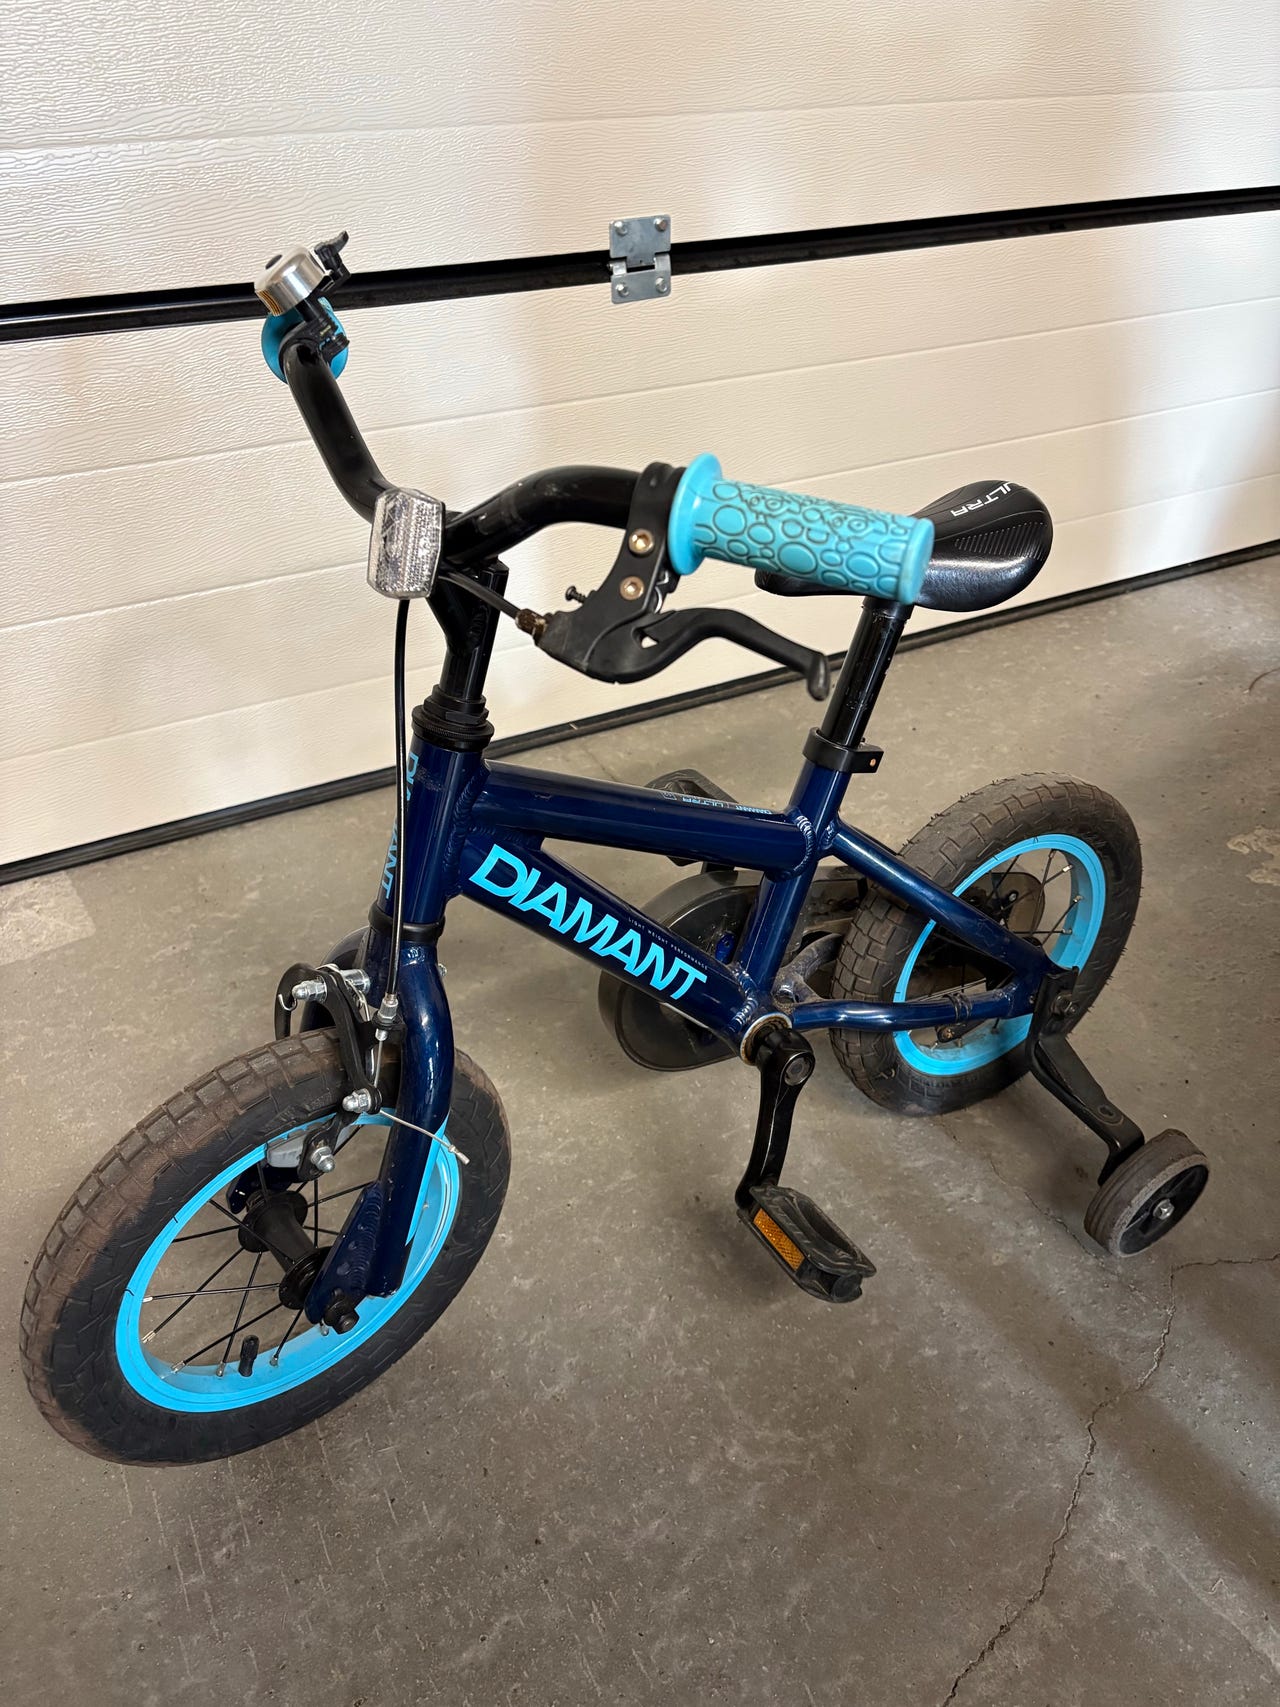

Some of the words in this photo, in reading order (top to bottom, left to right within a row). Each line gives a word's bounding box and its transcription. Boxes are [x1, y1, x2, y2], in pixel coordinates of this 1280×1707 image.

[382, 752, 419, 899] DIANT
[682, 796, 724, 808] ULTRA
[469, 843, 708, 1001] DIAMANT
[628, 917, 645, 930] LIGHT
[647, 929, 668, 945] WEIGHT
[670, 943, 708, 971] PERFORMANCE
